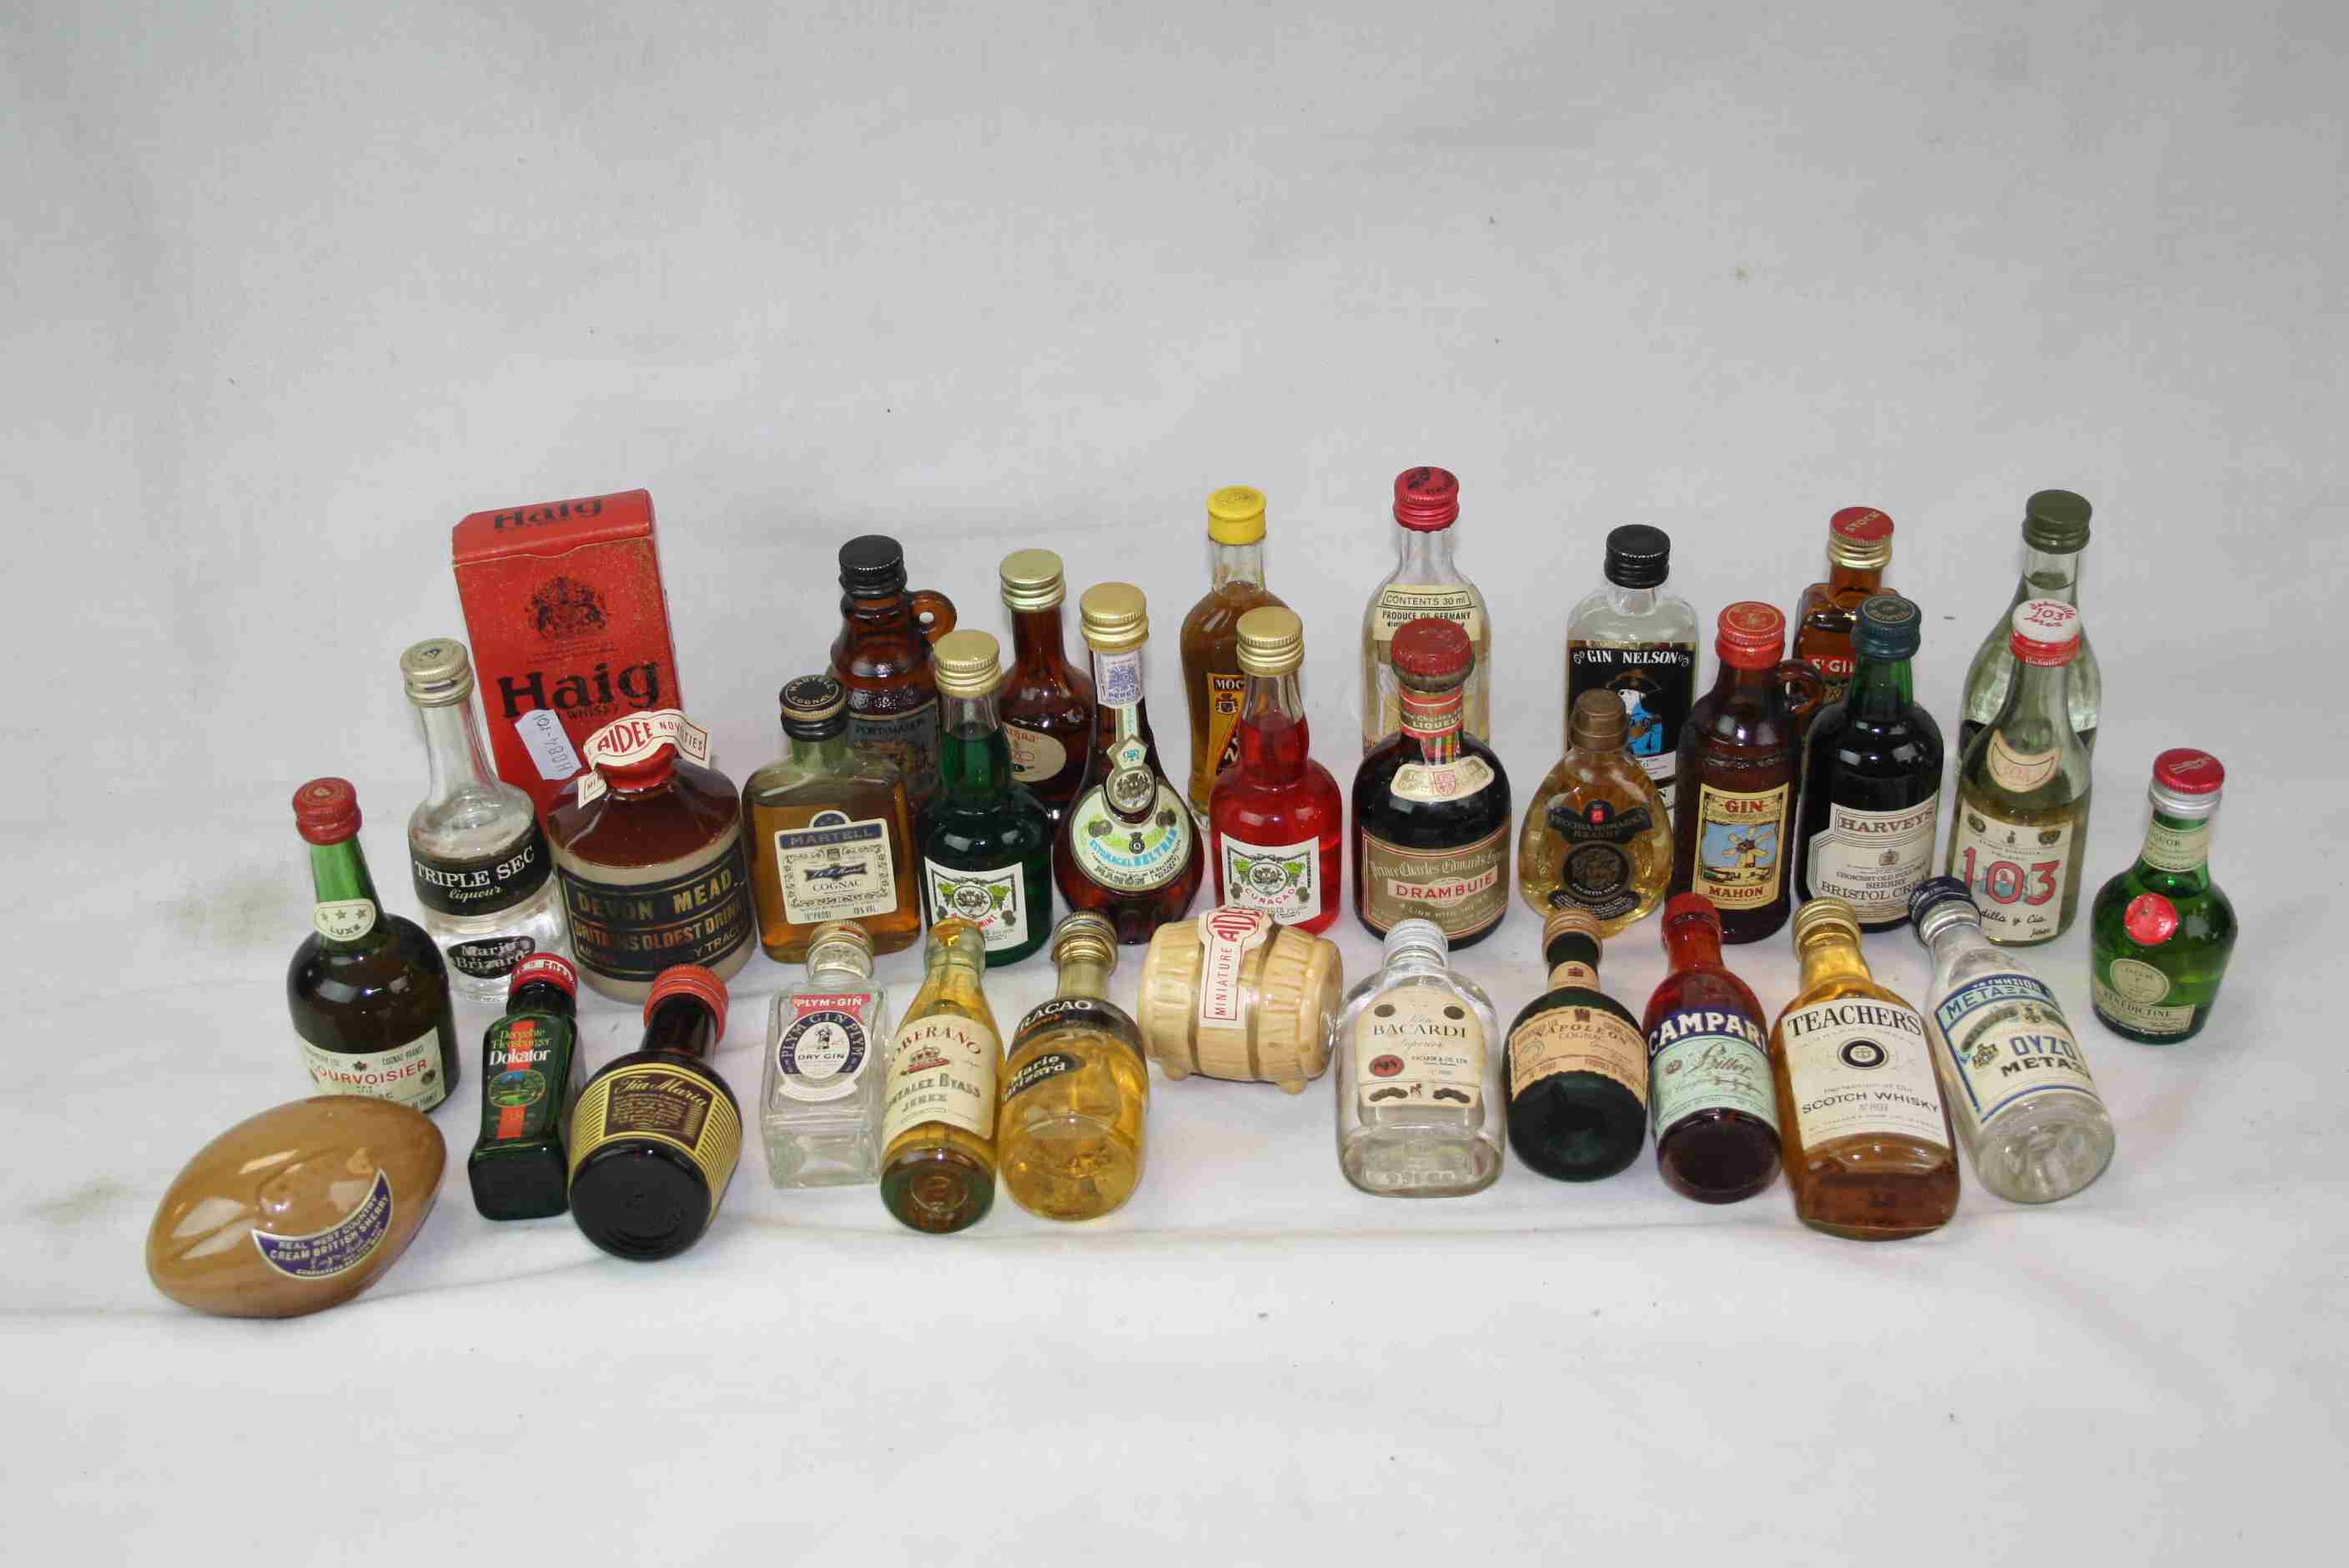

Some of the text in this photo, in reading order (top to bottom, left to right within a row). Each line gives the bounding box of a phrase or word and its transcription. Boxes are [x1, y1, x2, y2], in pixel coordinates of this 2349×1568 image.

[494, 499, 604, 530] Haig
[1386, 594, 1467, 606] CONTENTS 30 ml
[1382, 611, 1416, 621] PRODUCE
[1434, 611, 1471, 621] GERMANY
[2034, 609, 2065, 621] 103
[1587, 650, 1678, 665] GIN NELSON
[497, 661, 661, 719] Haig
[1215, 679, 1241, 691] MOC
[1725, 800, 1764, 814] GIN
[1840, 807, 1934, 833] HARVEY'S
[788, 829, 876, 847] MARTELL
[415, 844, 536, 889] TRIPLE SEC
[1964, 847, 2061, 906] 103
[448, 884, 503, 903] liqueur
[812, 879, 860, 892] COGNAC
[1396, 872, 1494, 899] DRAMBUIE
[1708, 886, 1764, 899] MAHON
[1821, 881, 1891, 902] BRISTOL
[576, 893, 654, 920] DEVON
[641, 923, 699, 948] OLDEST
[1215, 945, 1233, 1017] MINIATURE
[797, 997, 863, 1008] PLYM-GIN
[1374, 1023, 1466, 1038] BACARDI
[1787, 1005, 1923, 1038] TEACHER'S
[780, 1012, 865, 1058] PLYM GIN PLYM
[1648, 1011, 1768, 1058] CAMPARI
[490, 1048, 551, 1066] Dokator
[822, 1053, 845, 1061] GIN
[614, 1075, 708, 1106] Tia Maria
[1801, 1092, 1940, 1114] SCOTCH WHISKY
[269, 1249, 310, 1261] CREAM
